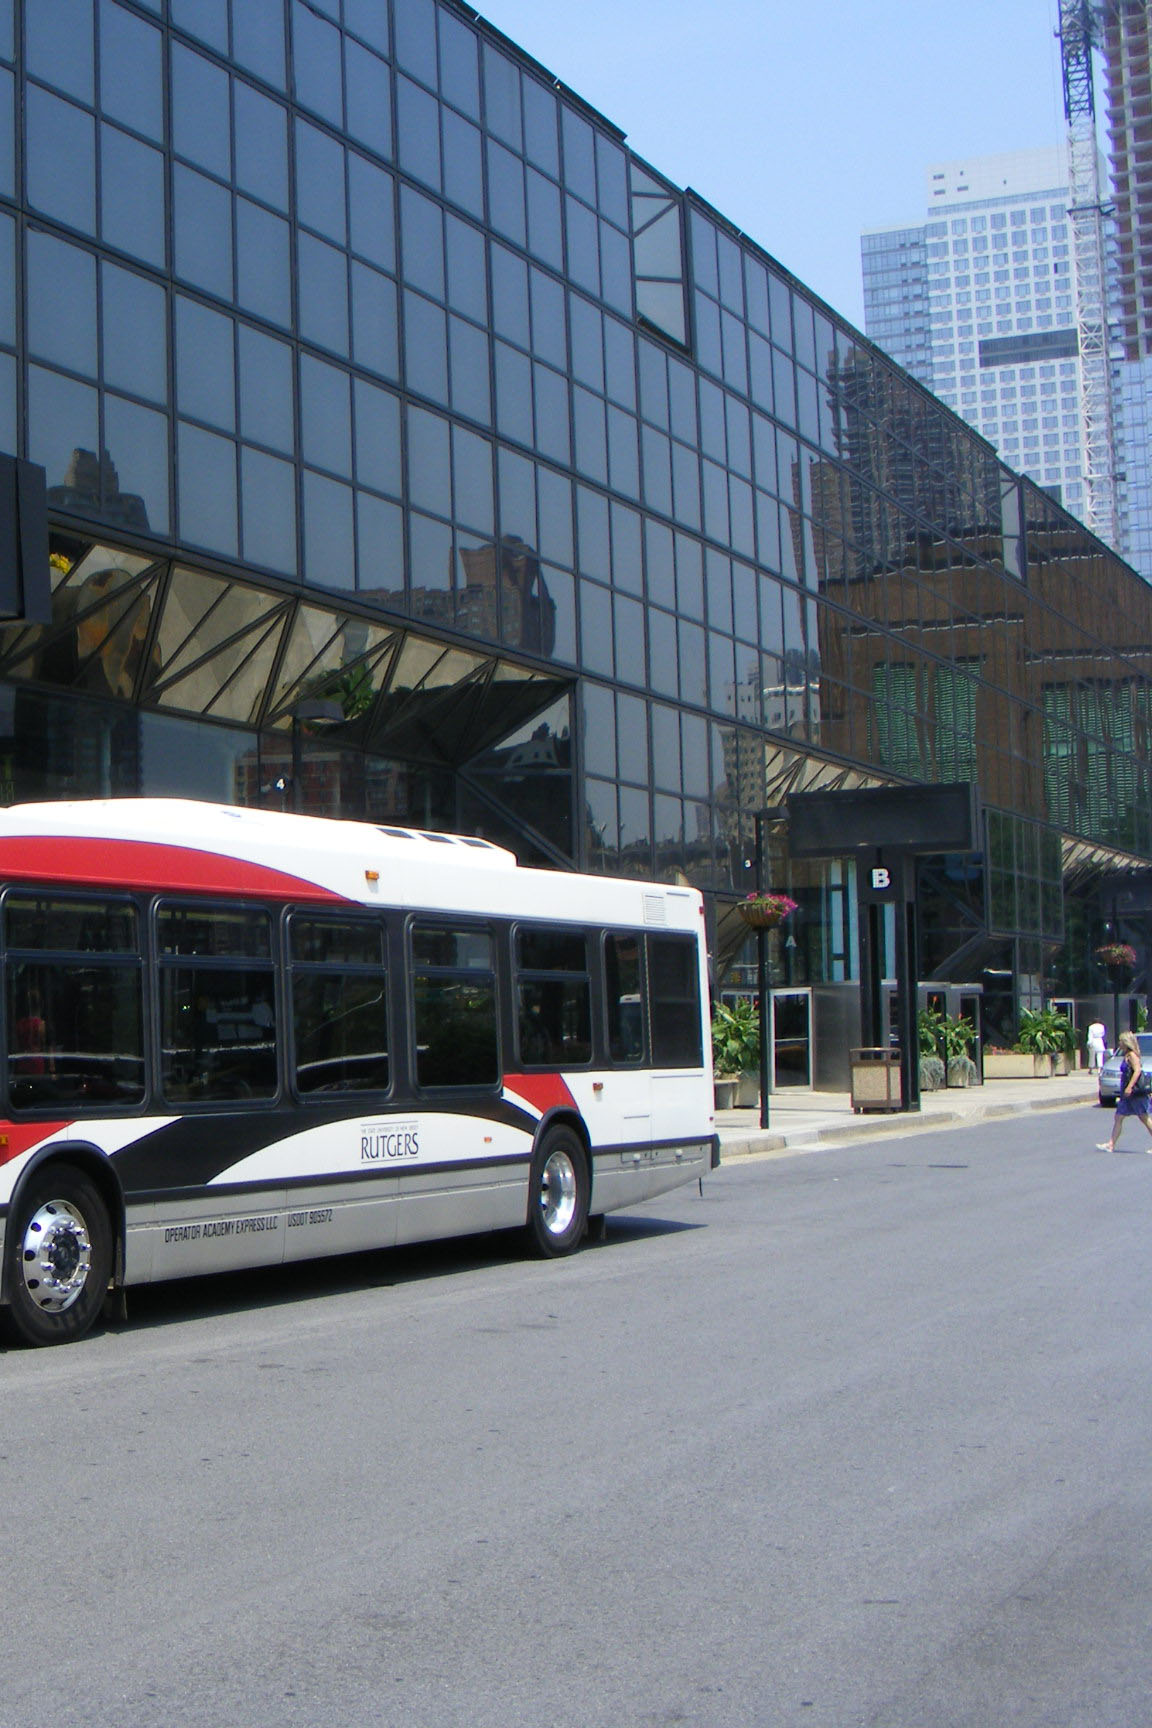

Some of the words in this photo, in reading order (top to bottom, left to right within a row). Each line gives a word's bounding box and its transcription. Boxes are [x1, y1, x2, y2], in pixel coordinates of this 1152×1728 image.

[276, 778, 285, 790] 4
[871, 867, 891, 889] B
[361, 1132, 419, 1160] RUTGERS
[164, 1225, 201, 1243] OPERATOR
[202, 1219, 235, 1239] ACADEMY
[235, 1216, 266, 1235] EXPRESS
[265, 1215, 278, 1230] LLC
